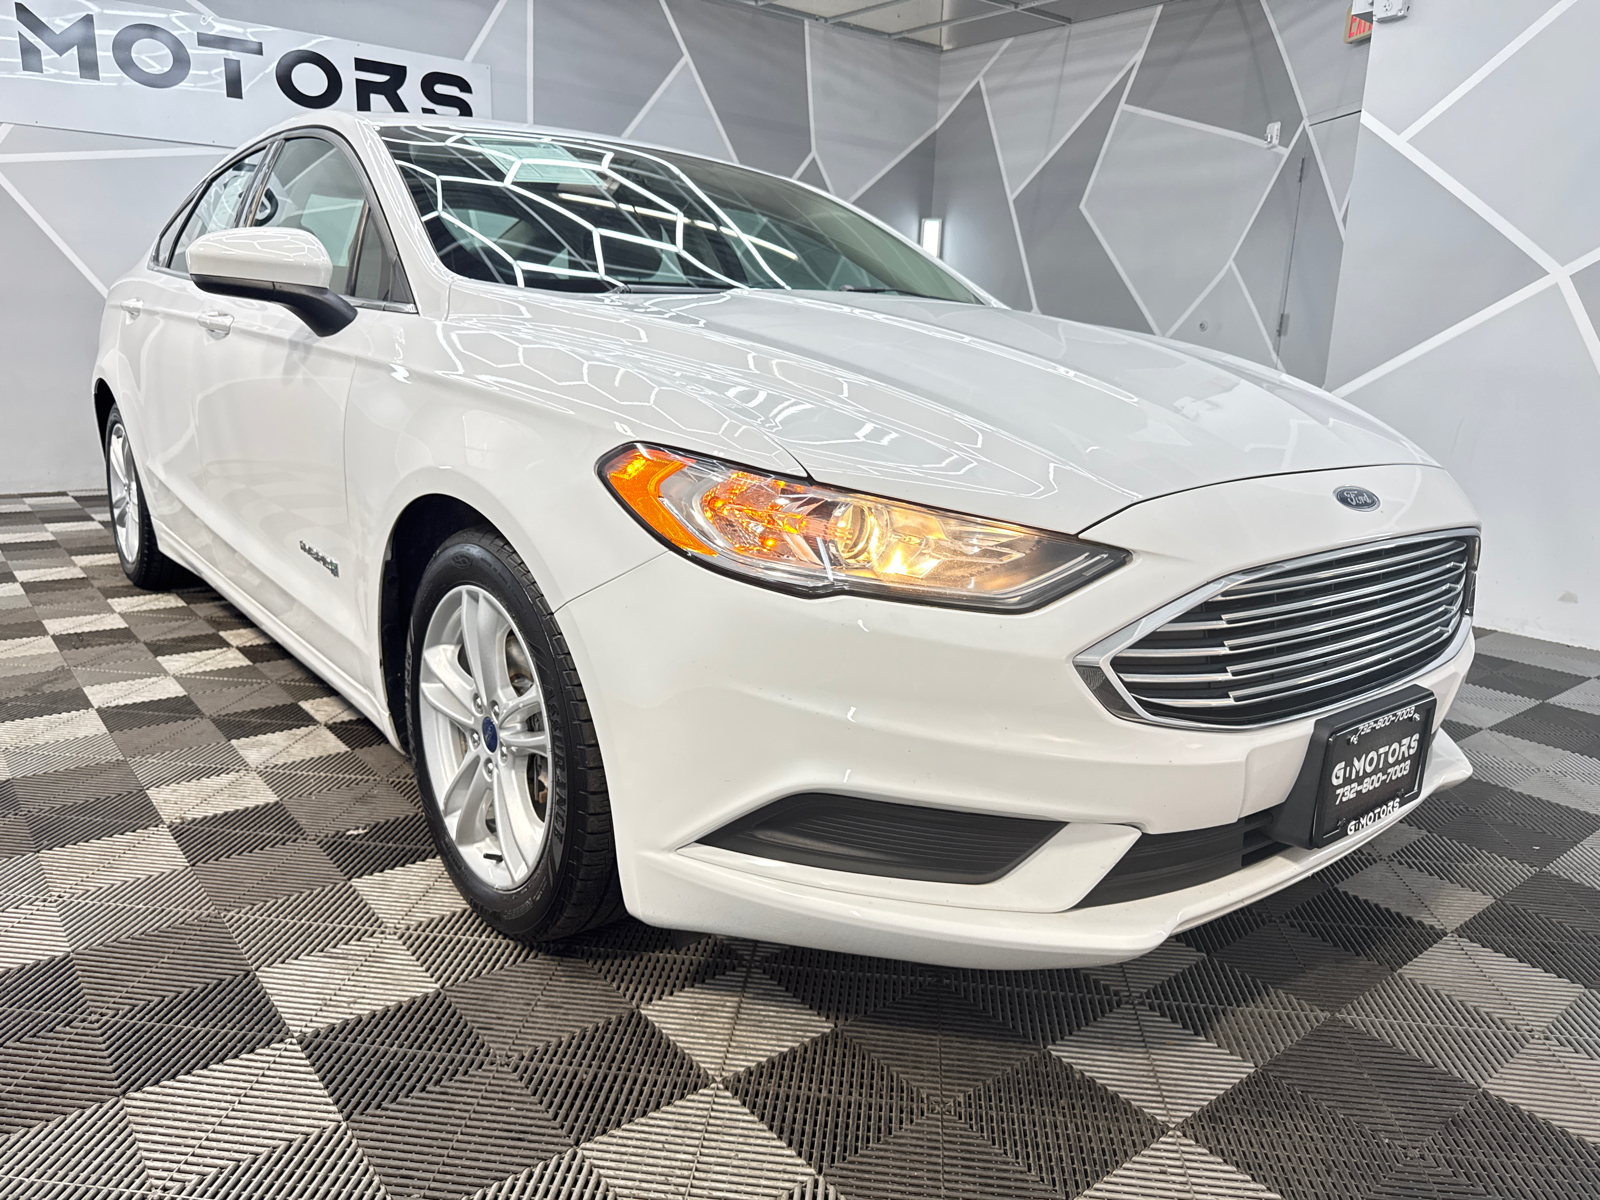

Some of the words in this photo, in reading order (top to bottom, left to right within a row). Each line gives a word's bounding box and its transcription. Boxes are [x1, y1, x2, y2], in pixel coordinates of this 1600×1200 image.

[15, 2, 474, 117] MOTORS
[1344, 490, 1371, 506] Ford
[1356, 706, 1416, 737] 732-800-7003
[544, 684, 567, 844] ASSURANCE
[1335, 760, 1411, 805] 732-800-7003
